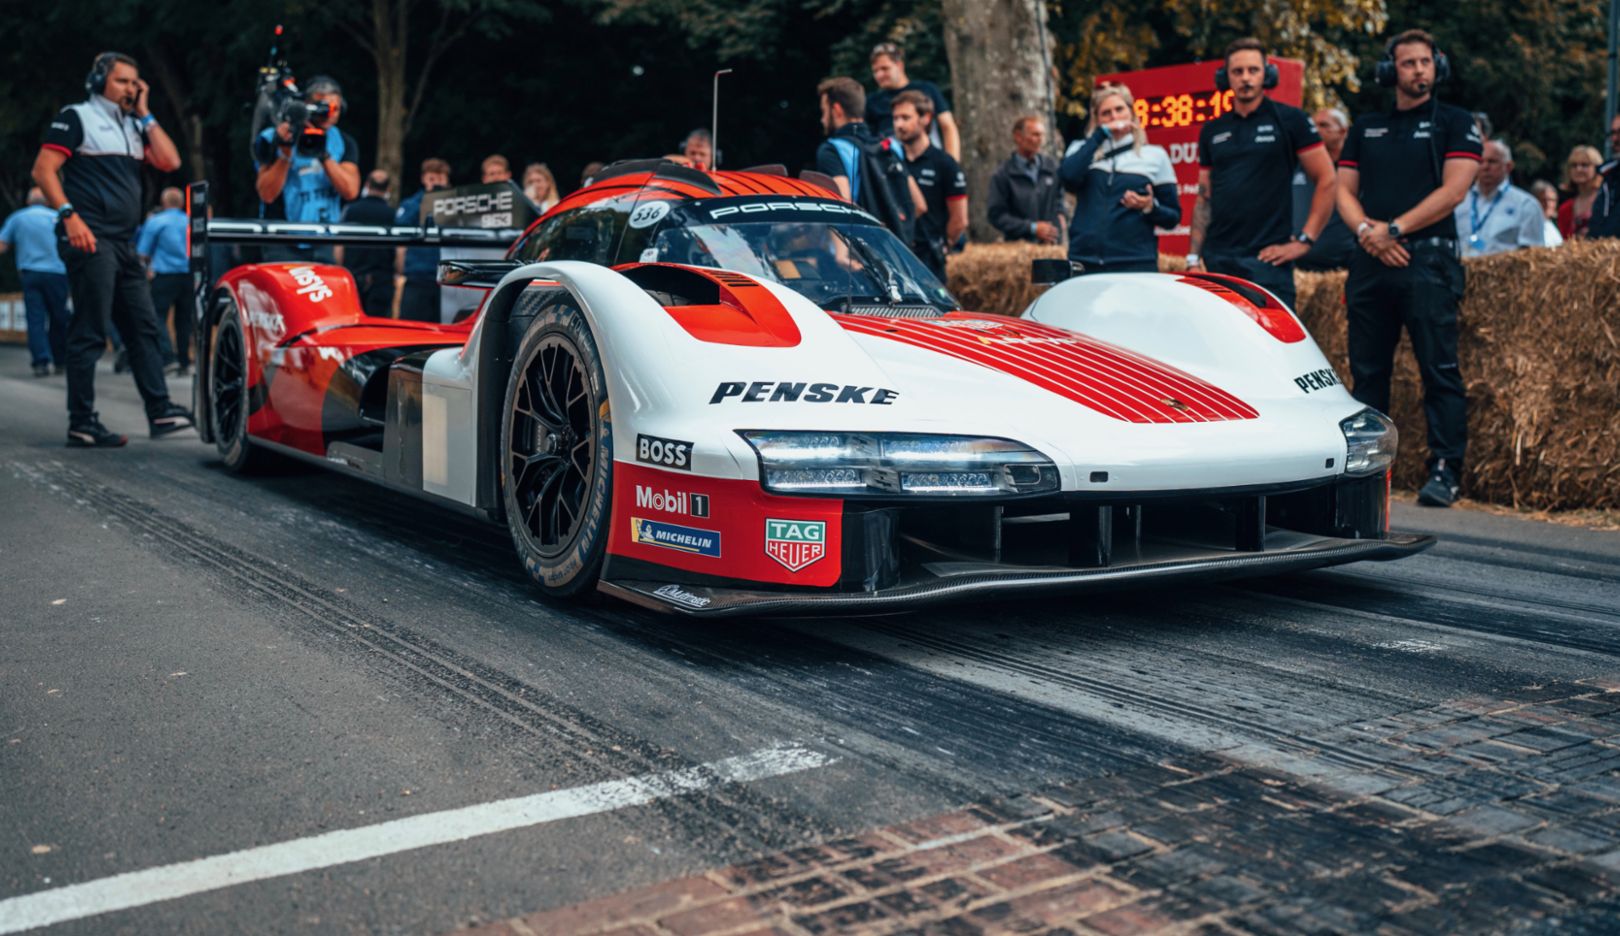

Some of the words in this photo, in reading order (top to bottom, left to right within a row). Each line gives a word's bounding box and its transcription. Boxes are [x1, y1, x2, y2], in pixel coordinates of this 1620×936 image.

[434, 191, 513, 216] PORSCHE
[481, 212, 513, 229] 963
[708, 381, 900, 405] PENSKE
[639, 438, 687, 466] BOSS
[635, 485, 687, 514] Mobil
[655, 529, 712, 549] MICHELIN
[771, 522, 820, 540] TAG
[769, 542, 821, 568] HEUER
